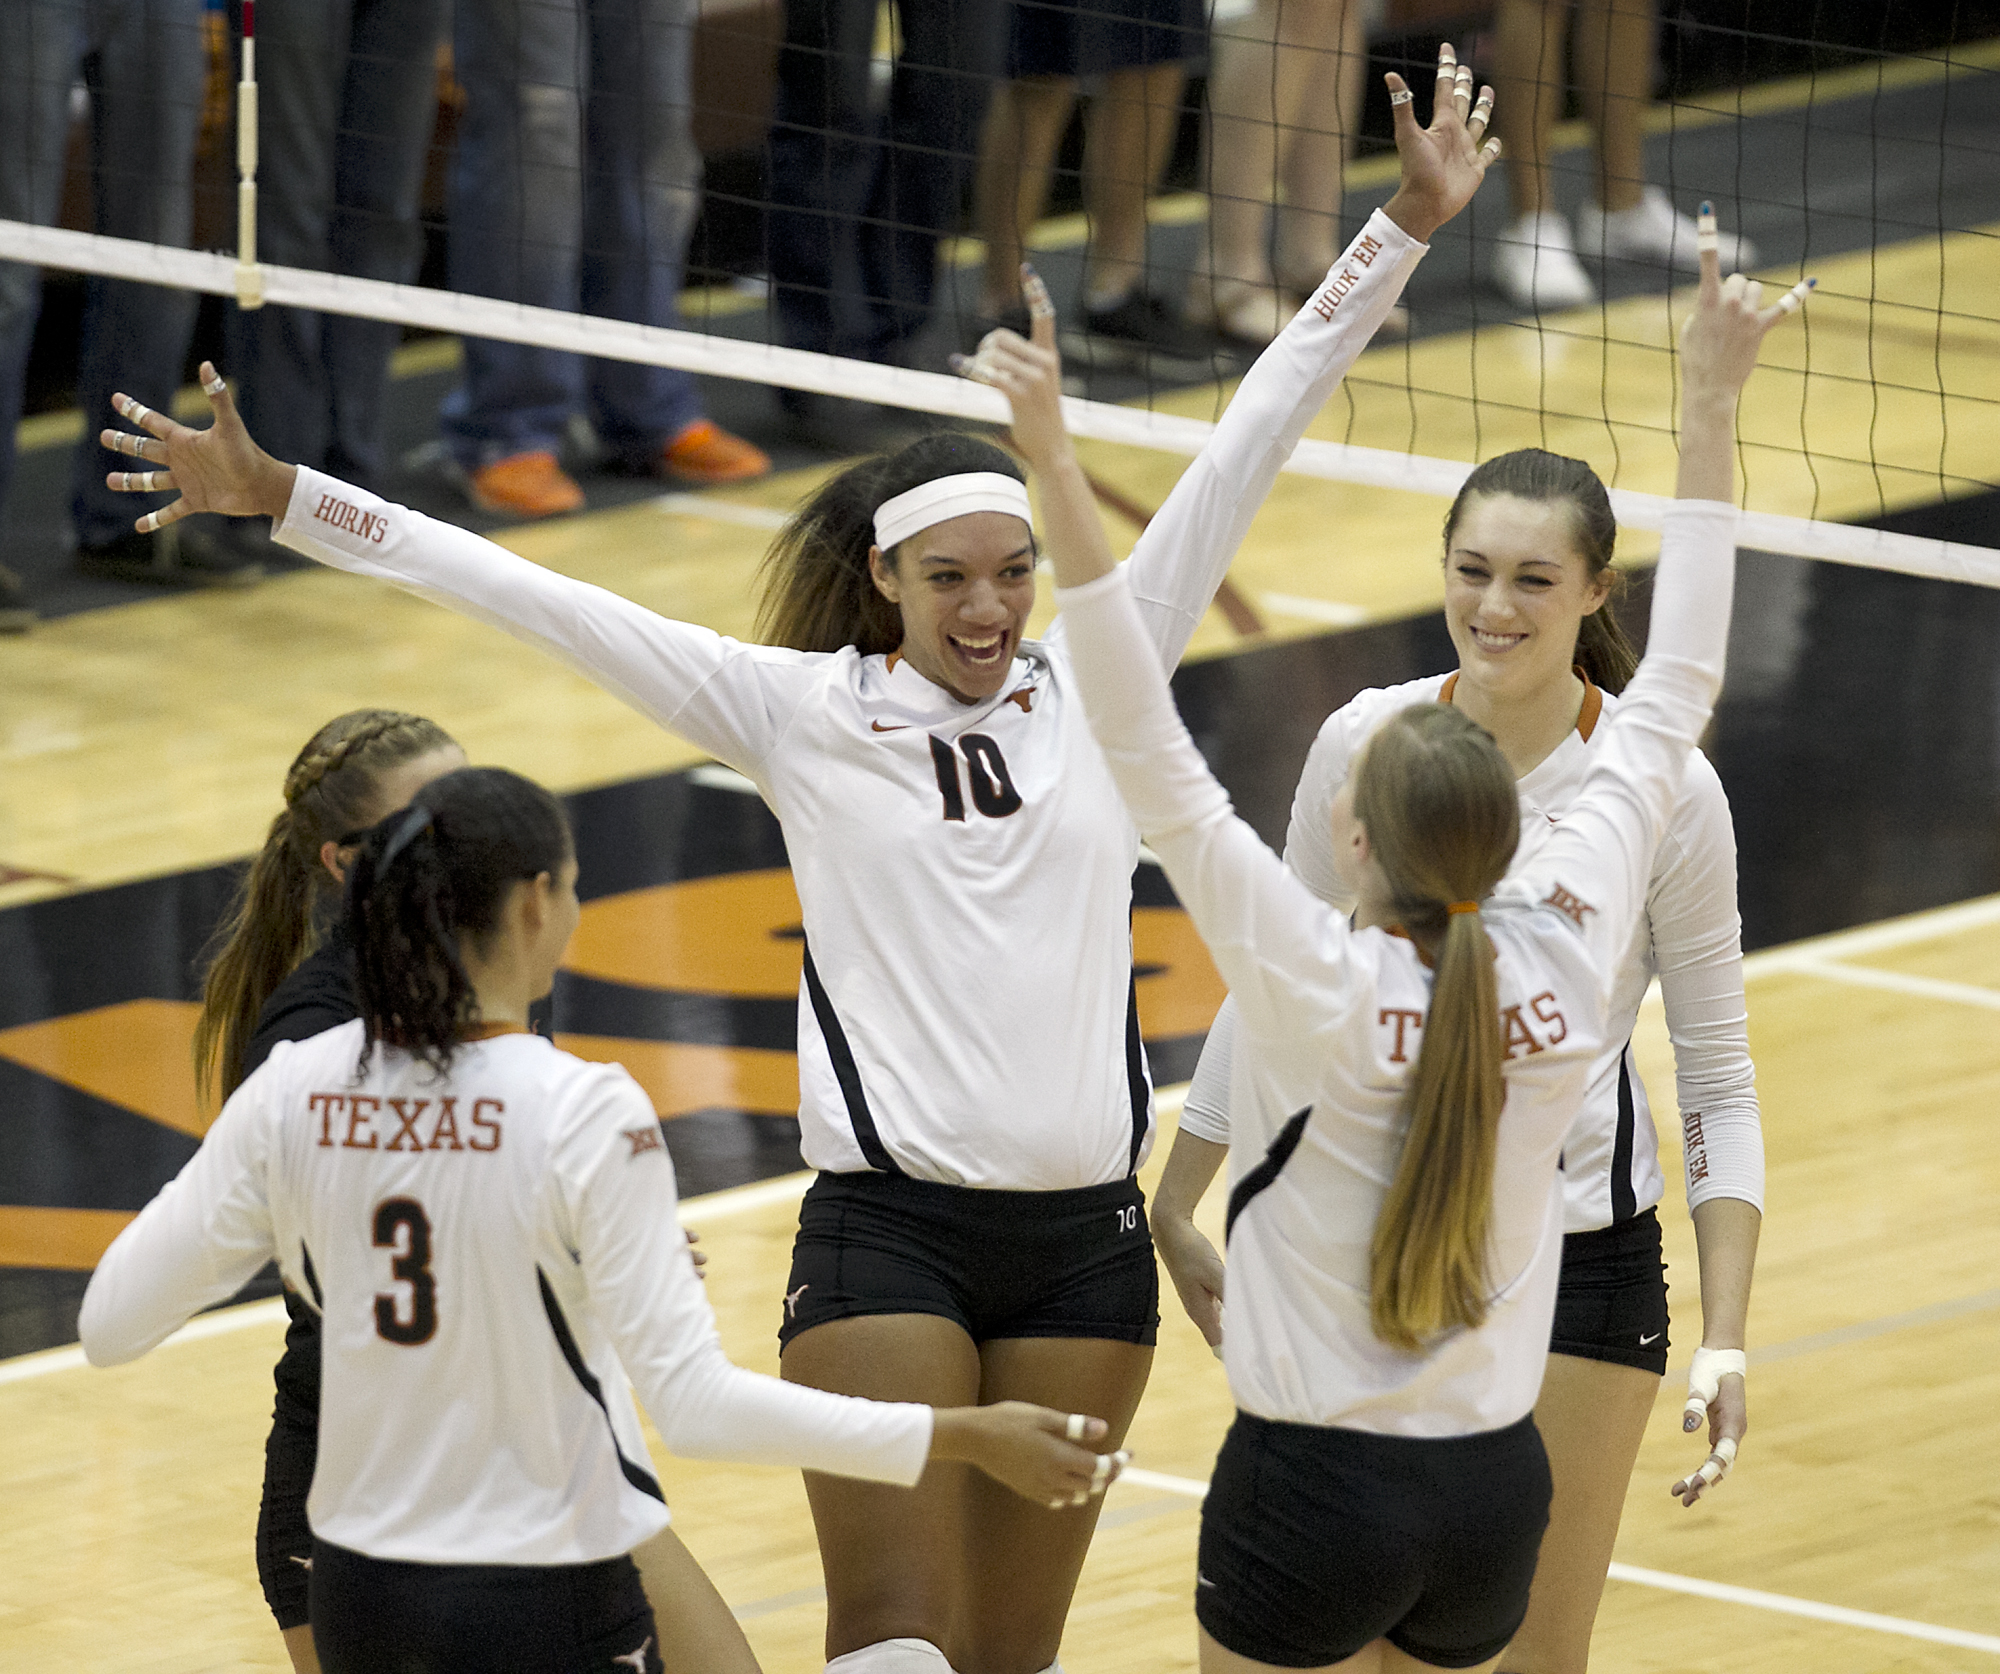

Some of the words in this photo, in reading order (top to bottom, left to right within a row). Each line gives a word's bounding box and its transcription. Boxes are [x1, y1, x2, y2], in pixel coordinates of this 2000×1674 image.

[1313, 268, 1359, 322] HOOK
[314, 494, 388, 543] HORNS
[928, 732, 1023, 822] 10
[1379, 991, 1567, 1067] TAS
[309, 1092, 504, 1152] TEXAS
[1116, 1205, 1137, 1233] 10
[372, 1195, 438, 1347] 3
